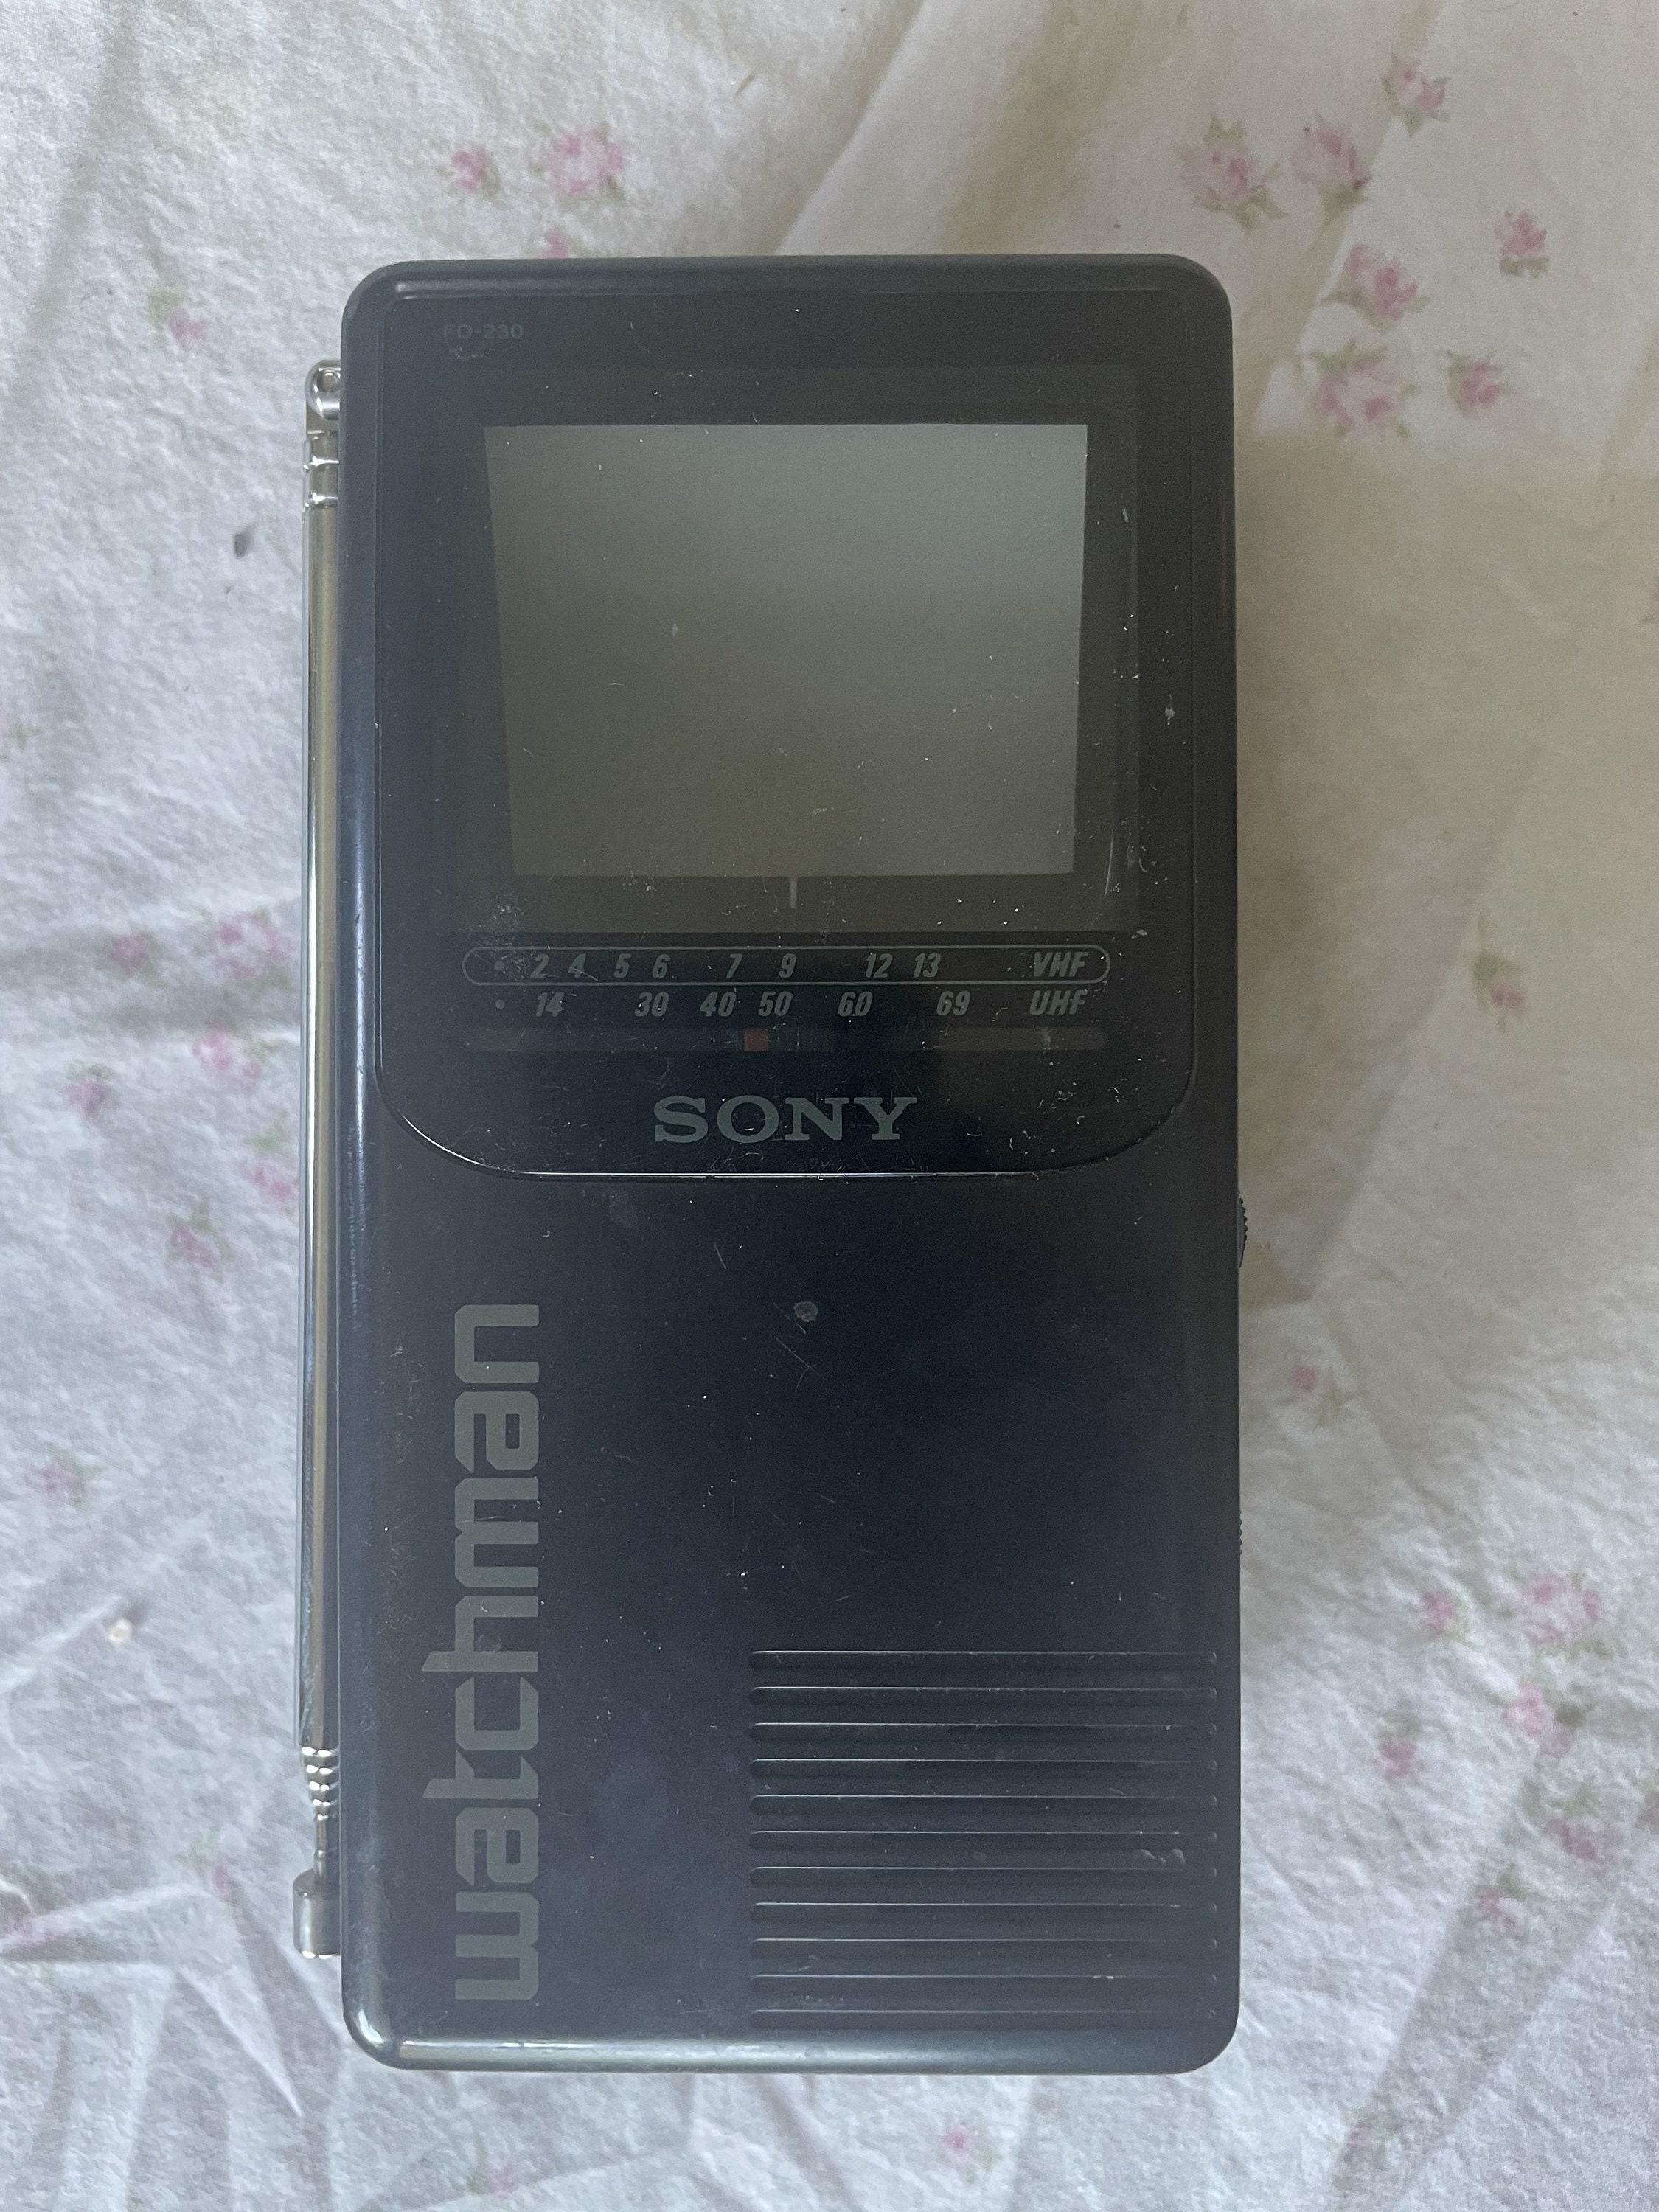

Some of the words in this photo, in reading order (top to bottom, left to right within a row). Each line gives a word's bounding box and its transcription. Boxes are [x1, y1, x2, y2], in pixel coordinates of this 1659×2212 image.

[444, 323, 523, 339] FD-230
[530, 953, 549, 979] 2
[568, 953, 586, 978] 4
[613, 953, 632, 978] 5
[653, 953, 670, 978] 6
[726, 953, 743, 978] 7
[779, 953, 797, 978] 9
[865, 953, 893, 978] 12
[913, 953, 942, 978] 13
[1033, 952, 1088, 978] VHF
[535, 992, 565, 1017] 14
[634, 992, 669, 1017] 30
[700, 992, 737, 1017] 40
[758, 991, 794, 1016] 50
[838, 991, 873, 1017] 60
[936, 990, 971, 1016] 69
[1030, 990, 1088, 1015] UHF
[654, 1095, 918, 1143] SONY
[422, 1304, 540, 2001] watchman
